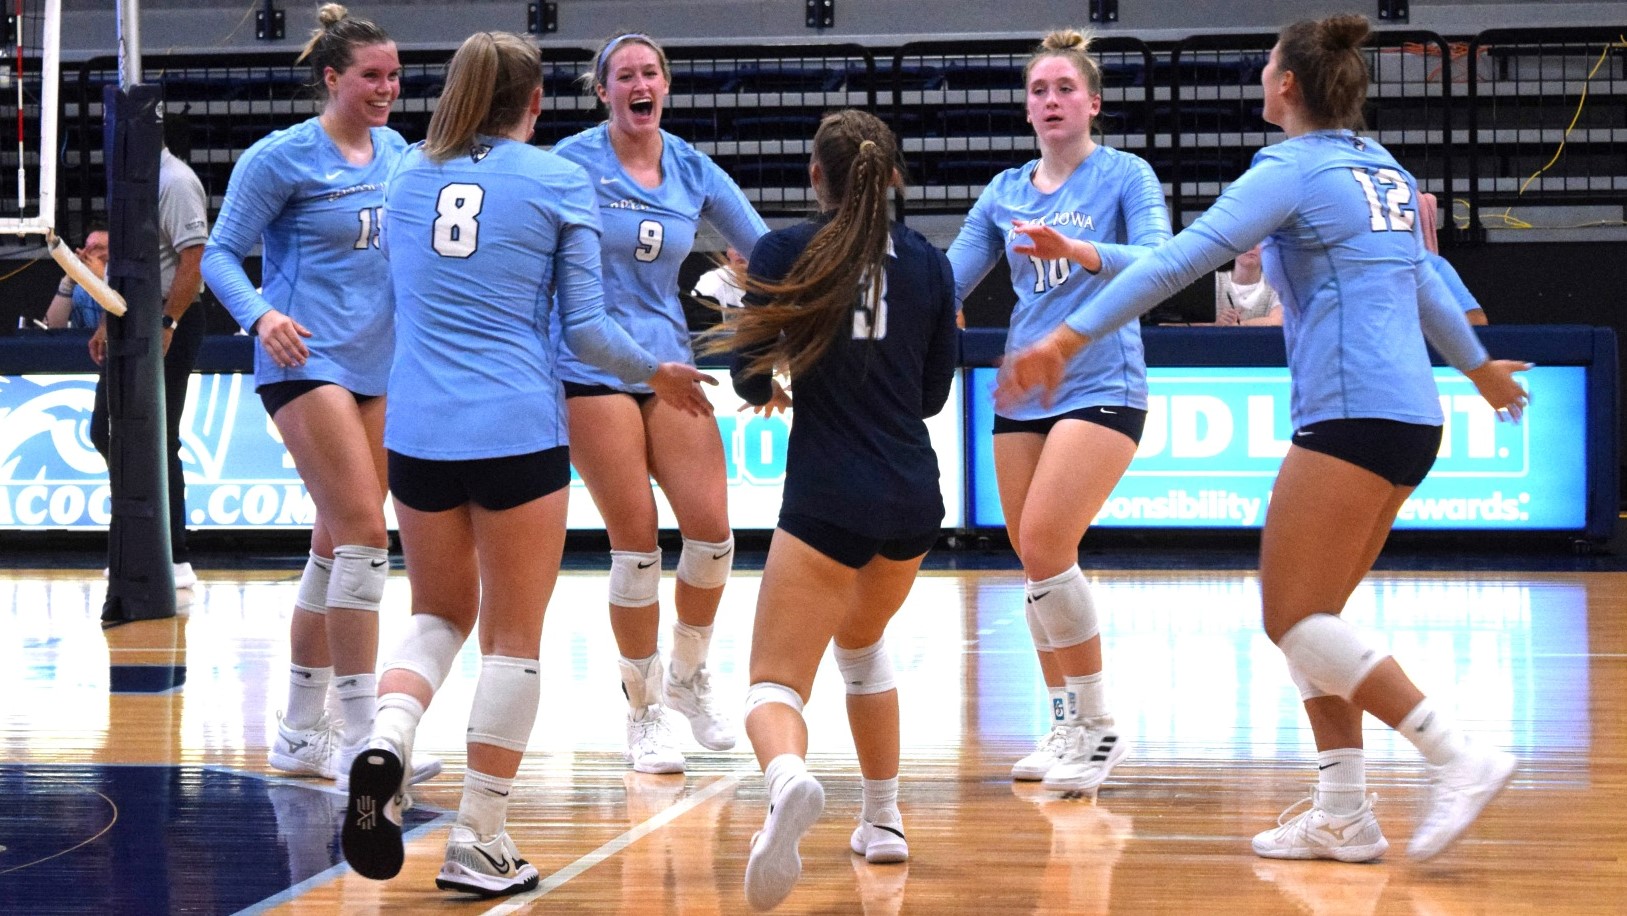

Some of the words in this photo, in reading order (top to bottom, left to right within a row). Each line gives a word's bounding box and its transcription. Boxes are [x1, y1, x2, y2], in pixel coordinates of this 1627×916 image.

[431, 181, 486, 259] 8
[1052, 210, 1096, 231] IOWA
[1351, 166, 1415, 233] 12
[633, 218, 665, 263] 9
[1028, 254, 1071, 294] 10
